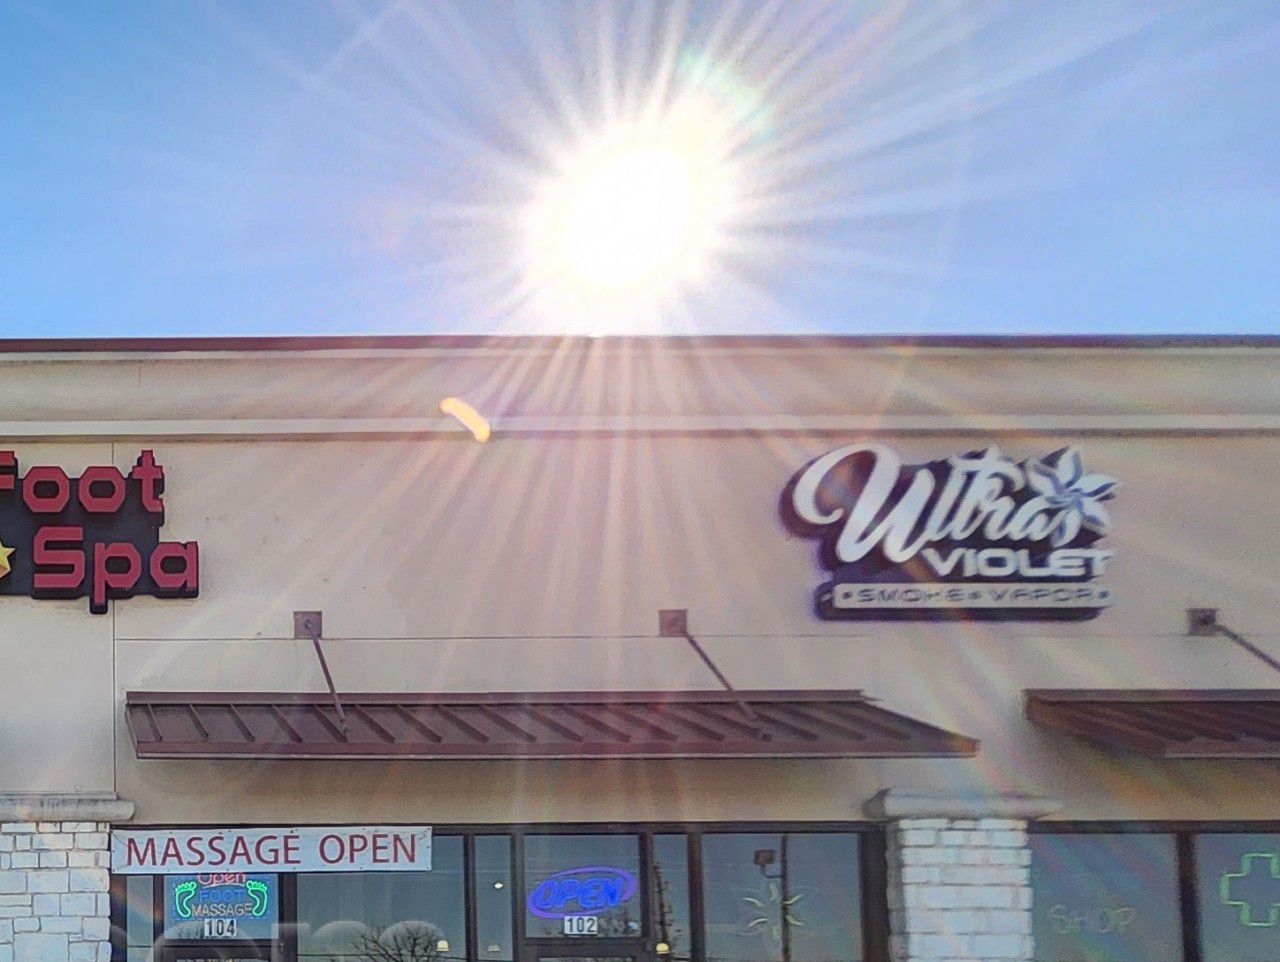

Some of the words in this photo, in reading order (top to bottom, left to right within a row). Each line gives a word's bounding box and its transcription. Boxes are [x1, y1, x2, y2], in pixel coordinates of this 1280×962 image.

[33, 527, 198, 604] Spa
[921, 547, 1114, 578] VIOLET
[126, 835, 301, 867] MASSAGE
[318, 833, 417, 865] OPEN
[200, 889, 245, 903] FOOT
[533, 877, 624, 910] OPEN
[191, 902, 254, 918] MASSAGE
[205, 919, 236, 936] 104
[564, 916, 597, 934] 102
